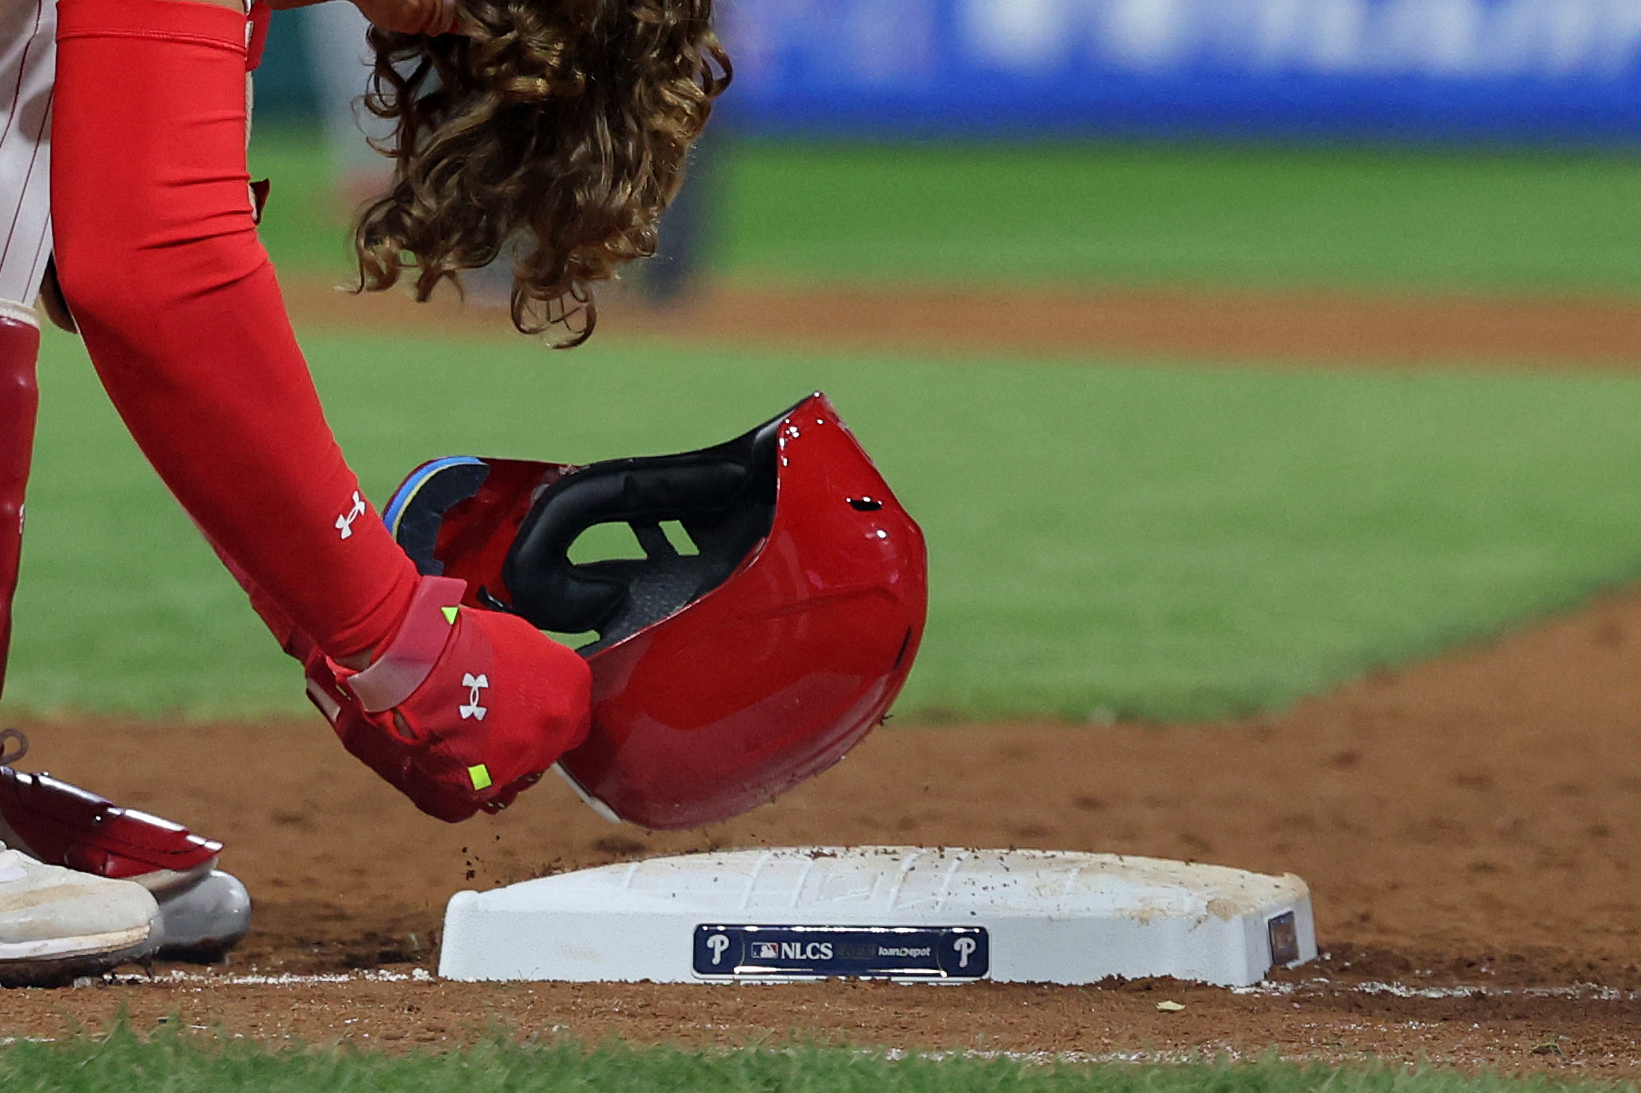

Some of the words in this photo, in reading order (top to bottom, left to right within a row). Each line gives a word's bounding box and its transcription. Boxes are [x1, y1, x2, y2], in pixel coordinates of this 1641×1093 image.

[706, 934, 730, 965] P
[781, 942, 834, 960] NLCS
[953, 937, 977, 968] P
